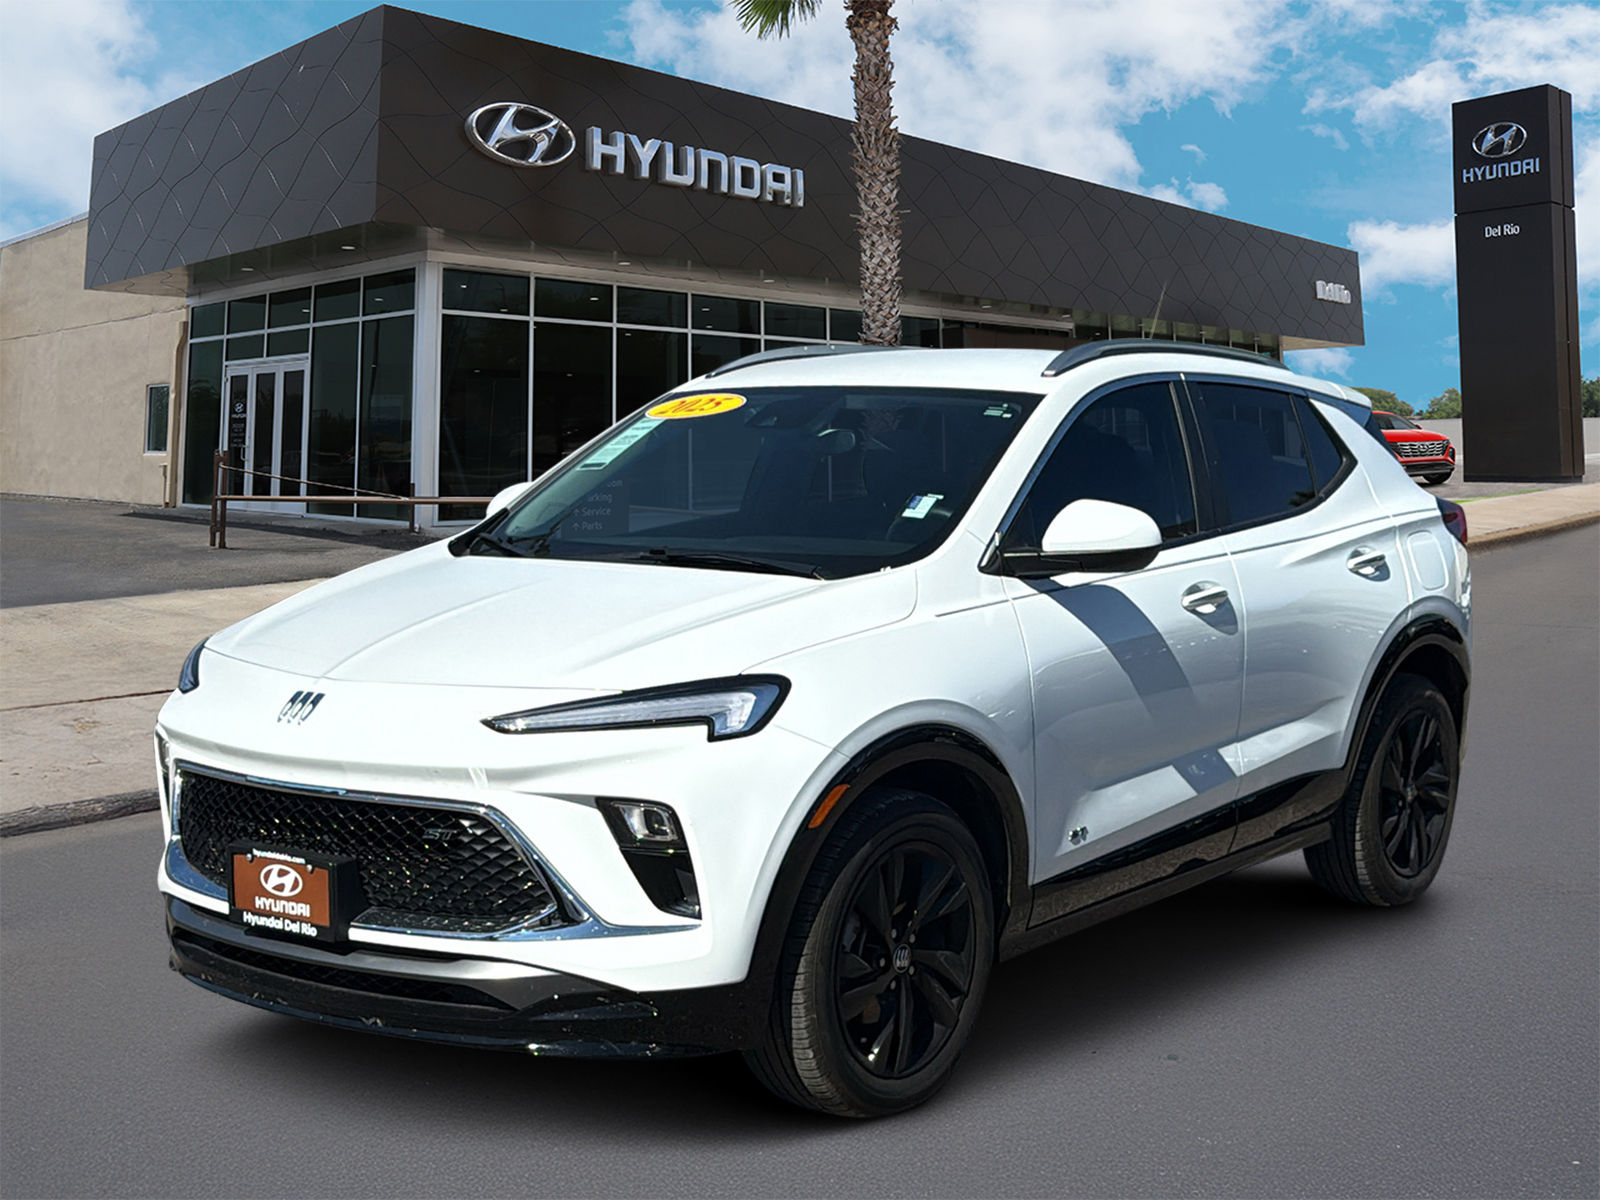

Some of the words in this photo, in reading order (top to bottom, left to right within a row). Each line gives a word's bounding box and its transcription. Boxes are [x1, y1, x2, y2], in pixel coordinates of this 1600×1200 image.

[586, 126, 805, 208] HYUNDAI
[1462, 157, 1540, 184] HYUNDAI
[1484, 225, 1501, 238] Del
[1503, 223, 1520, 236] Rio
[654, 397, 734, 415] 2025
[587, 493, 612, 504] arking
[581, 506, 611, 517] Service
[581, 521, 603, 531] Parts
[255, 896, 310, 917] HYUNDAI
[243, 911, 283, 930] Hyundai
[284, 919, 300, 934] Del
[301, 921, 318, 937] Rio
